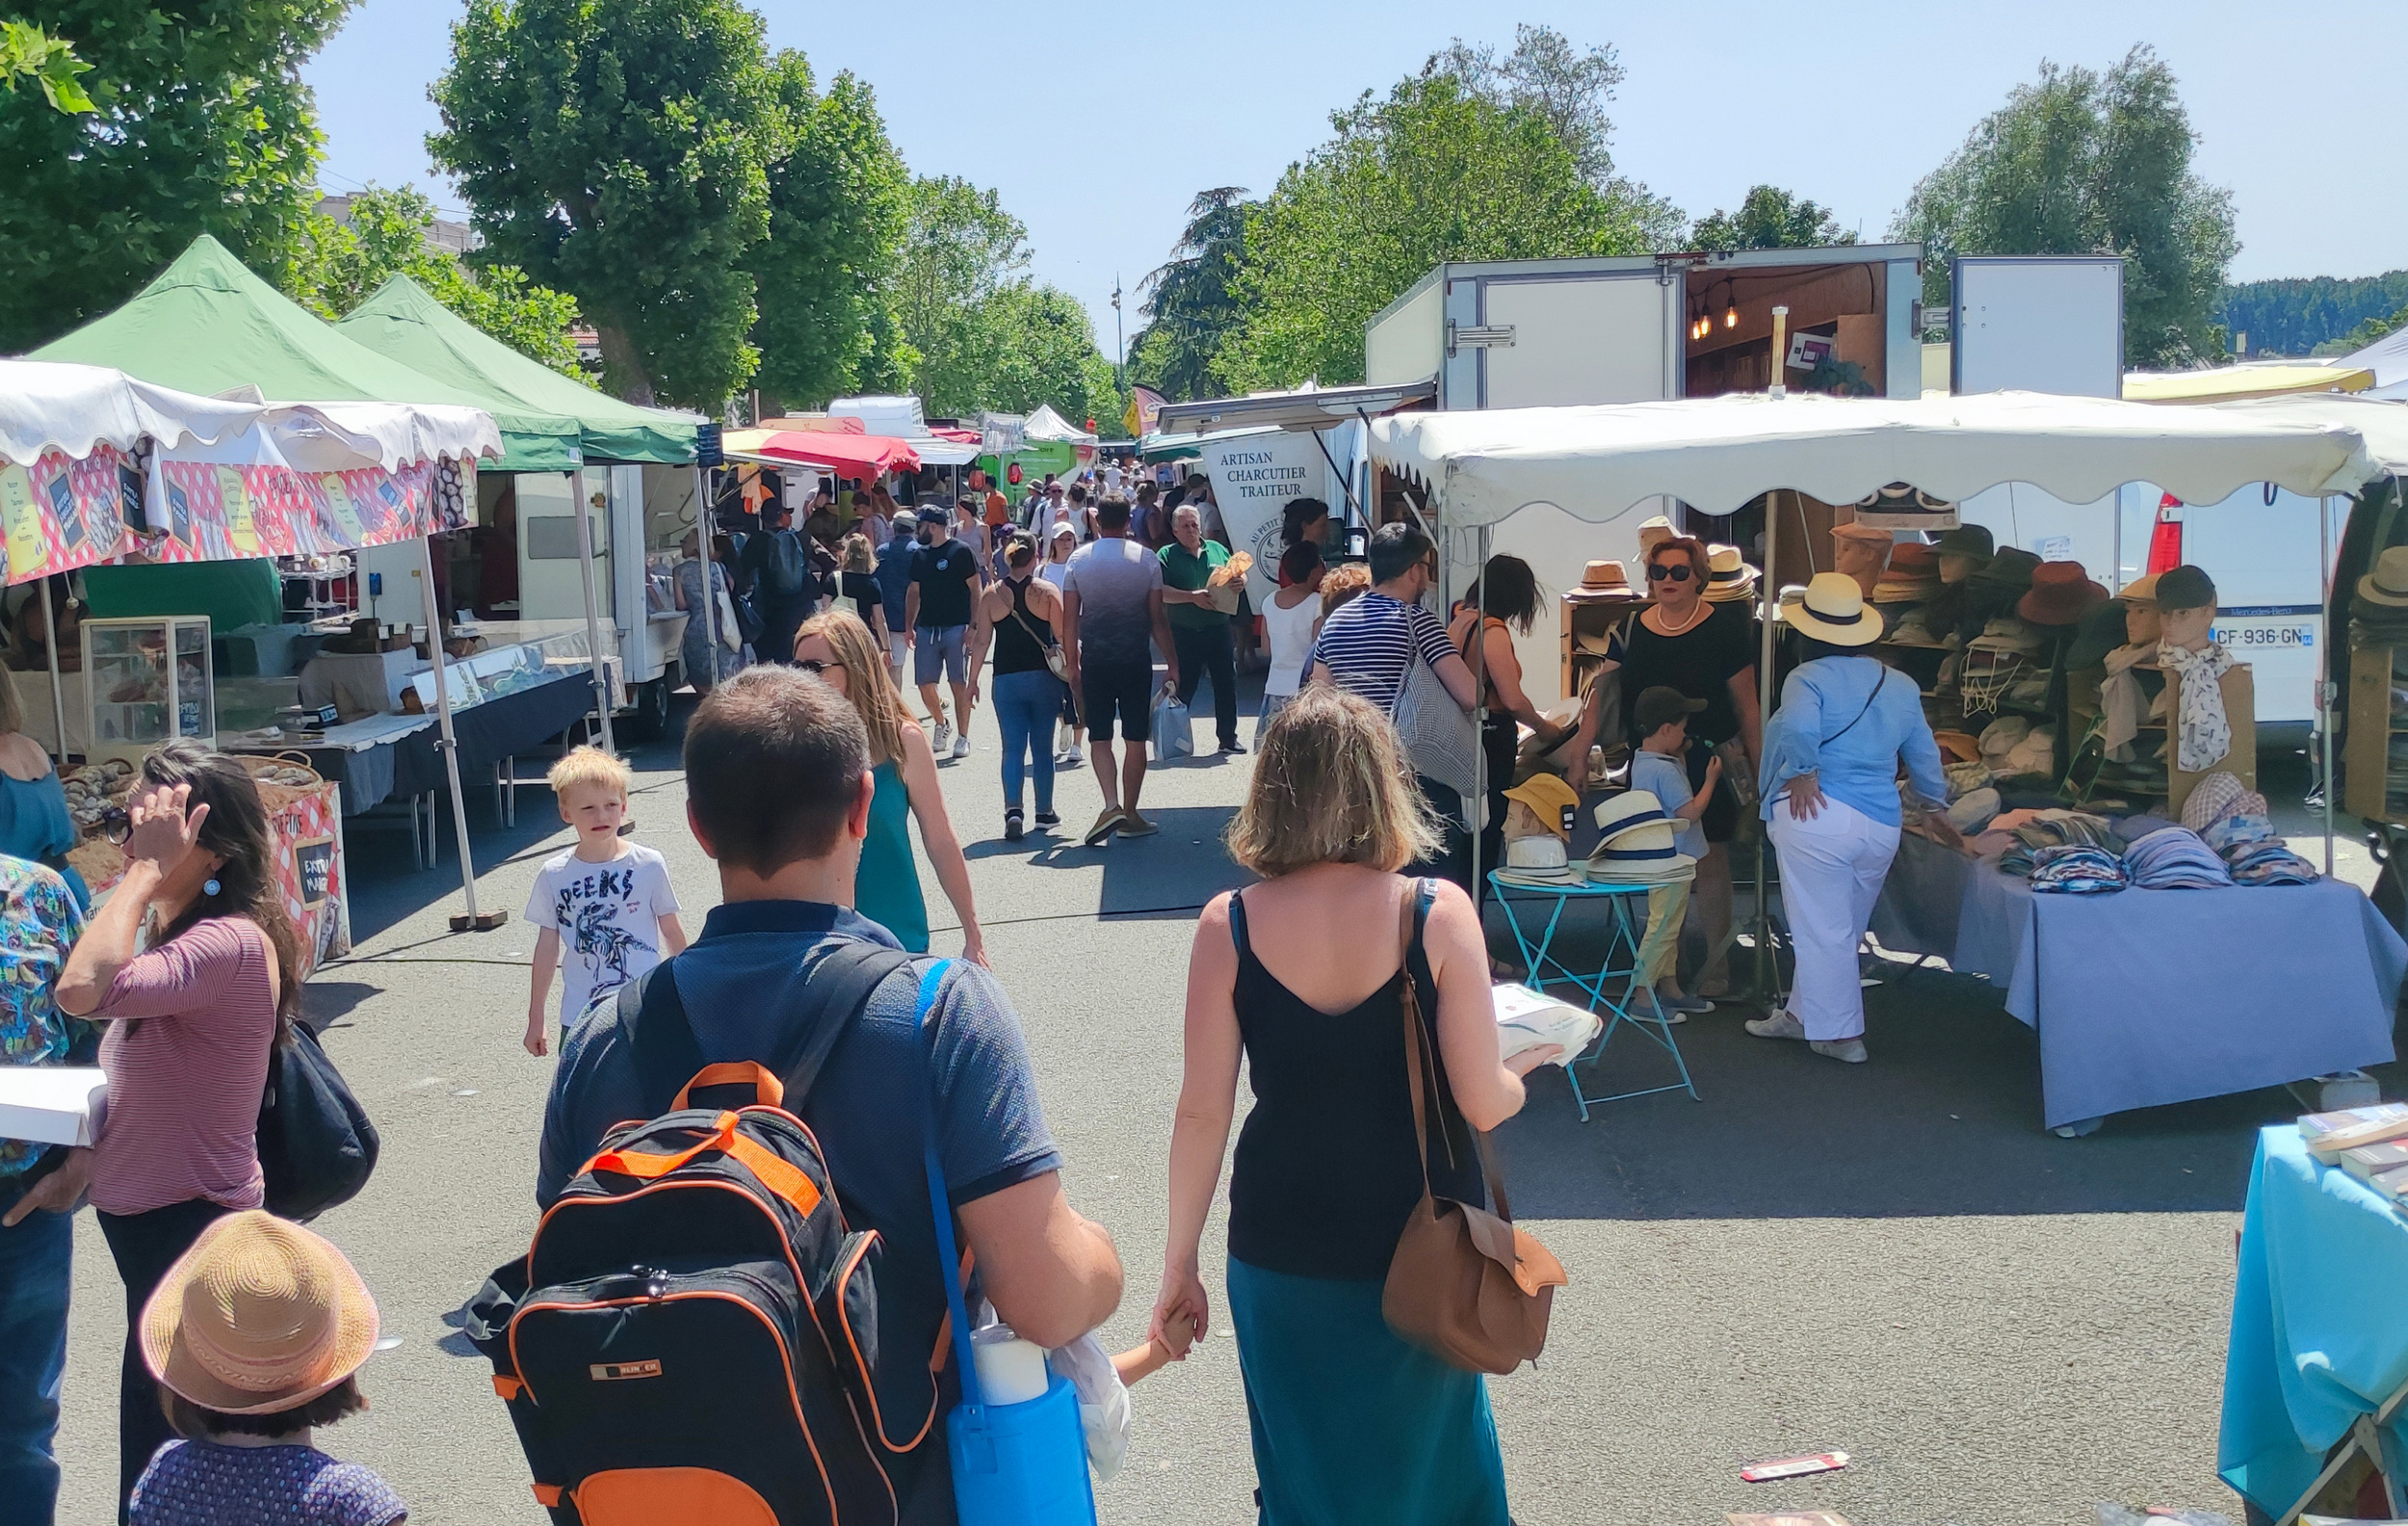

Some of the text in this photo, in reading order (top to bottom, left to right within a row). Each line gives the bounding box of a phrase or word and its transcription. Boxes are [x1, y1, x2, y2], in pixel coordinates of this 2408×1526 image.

[1220, 452, 1273, 466] ARTISAN
[1227, 466, 1307, 483] CHARCUTIER
[1240, 483, 1302, 498] TRAITEUR
[1250, 517, 1280, 546] AU PETIT
[2230, 607, 2293, 617] Mercedes-Benz
[2216, 628, 2302, 645] CF-936-GN
